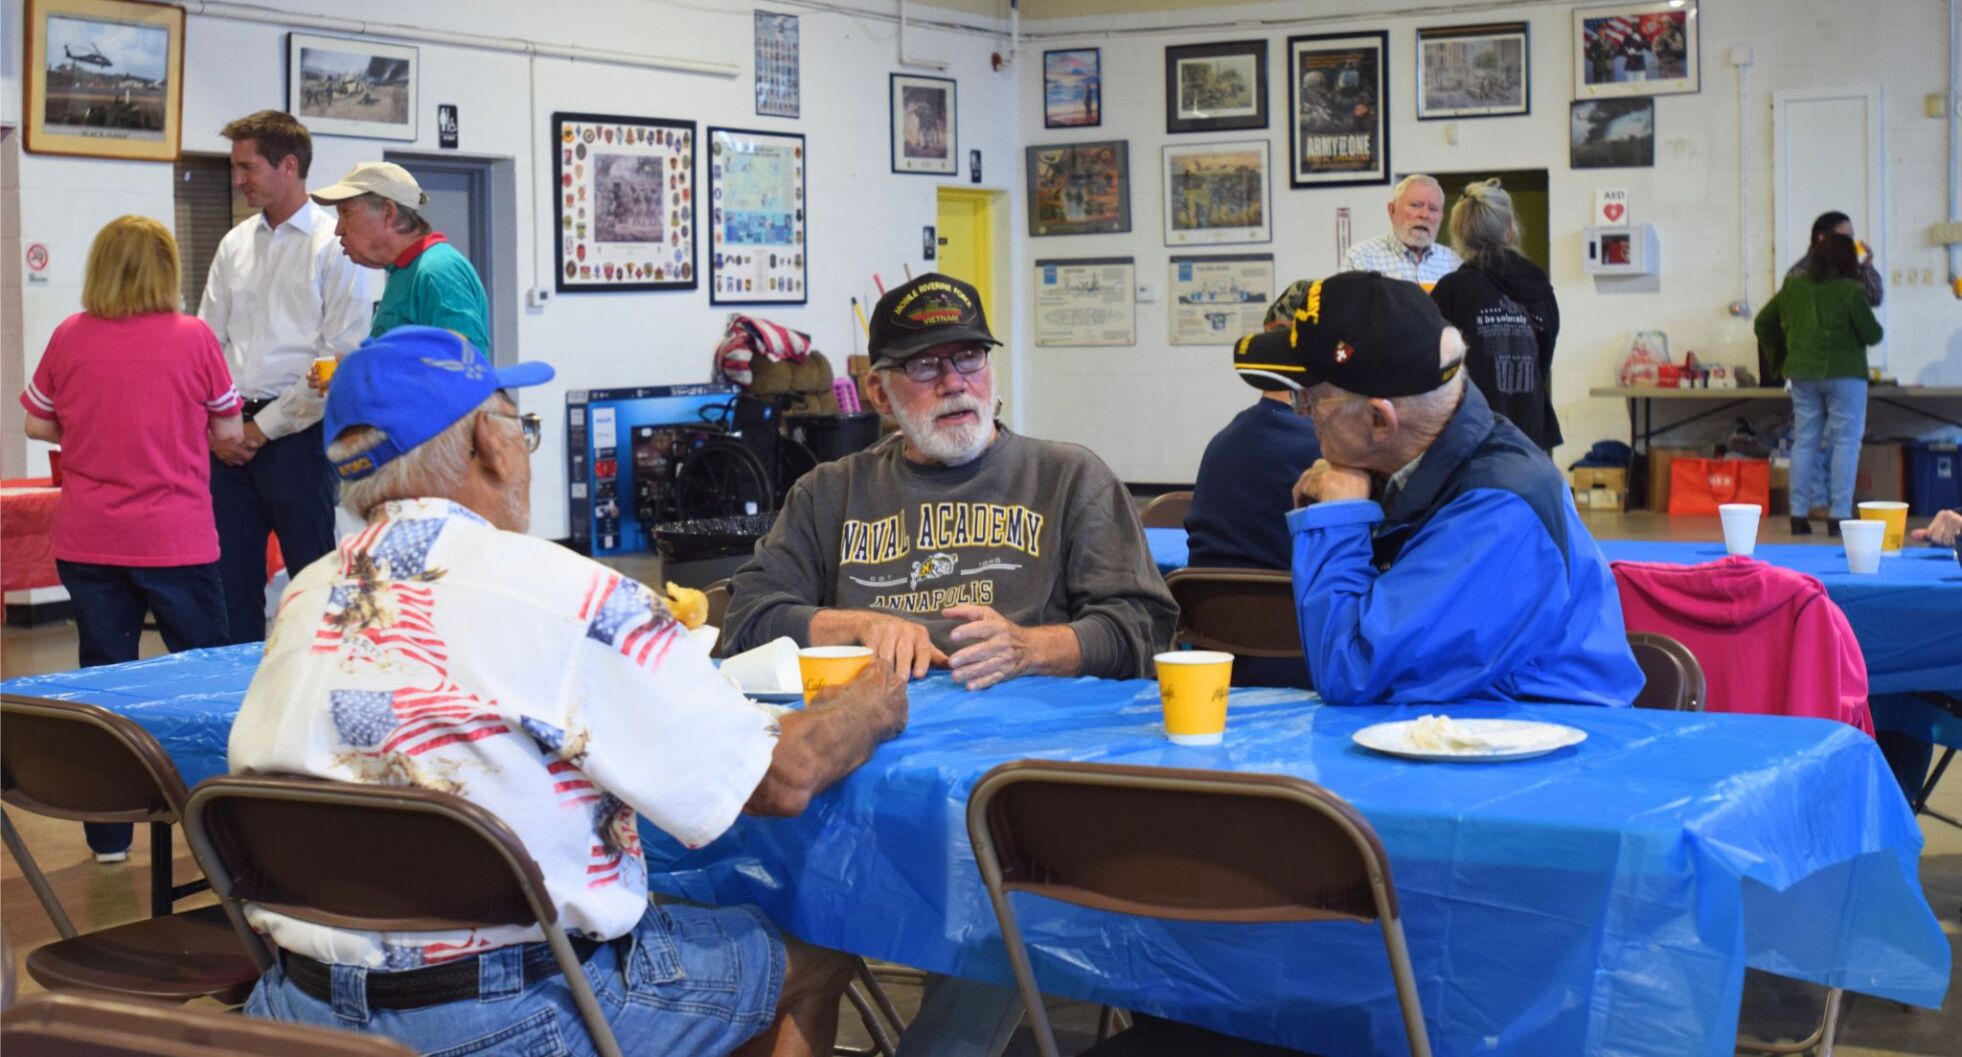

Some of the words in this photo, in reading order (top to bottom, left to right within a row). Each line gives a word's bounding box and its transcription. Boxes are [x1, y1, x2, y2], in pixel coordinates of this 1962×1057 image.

[1306, 136, 1339, 157] ARMY
[1347, 134, 1370, 156] ONE
[1604, 191, 1625, 199] AED
[894, 289, 919, 316] MOBILE
[918, 281, 952, 294] RIVERINE
[922, 314, 959, 325] VIETNAM
[840, 508, 910, 564] NAVAL
[917, 502, 1043, 557] ACADEMY
[869, 579, 993, 613] ANNAPOLIS
